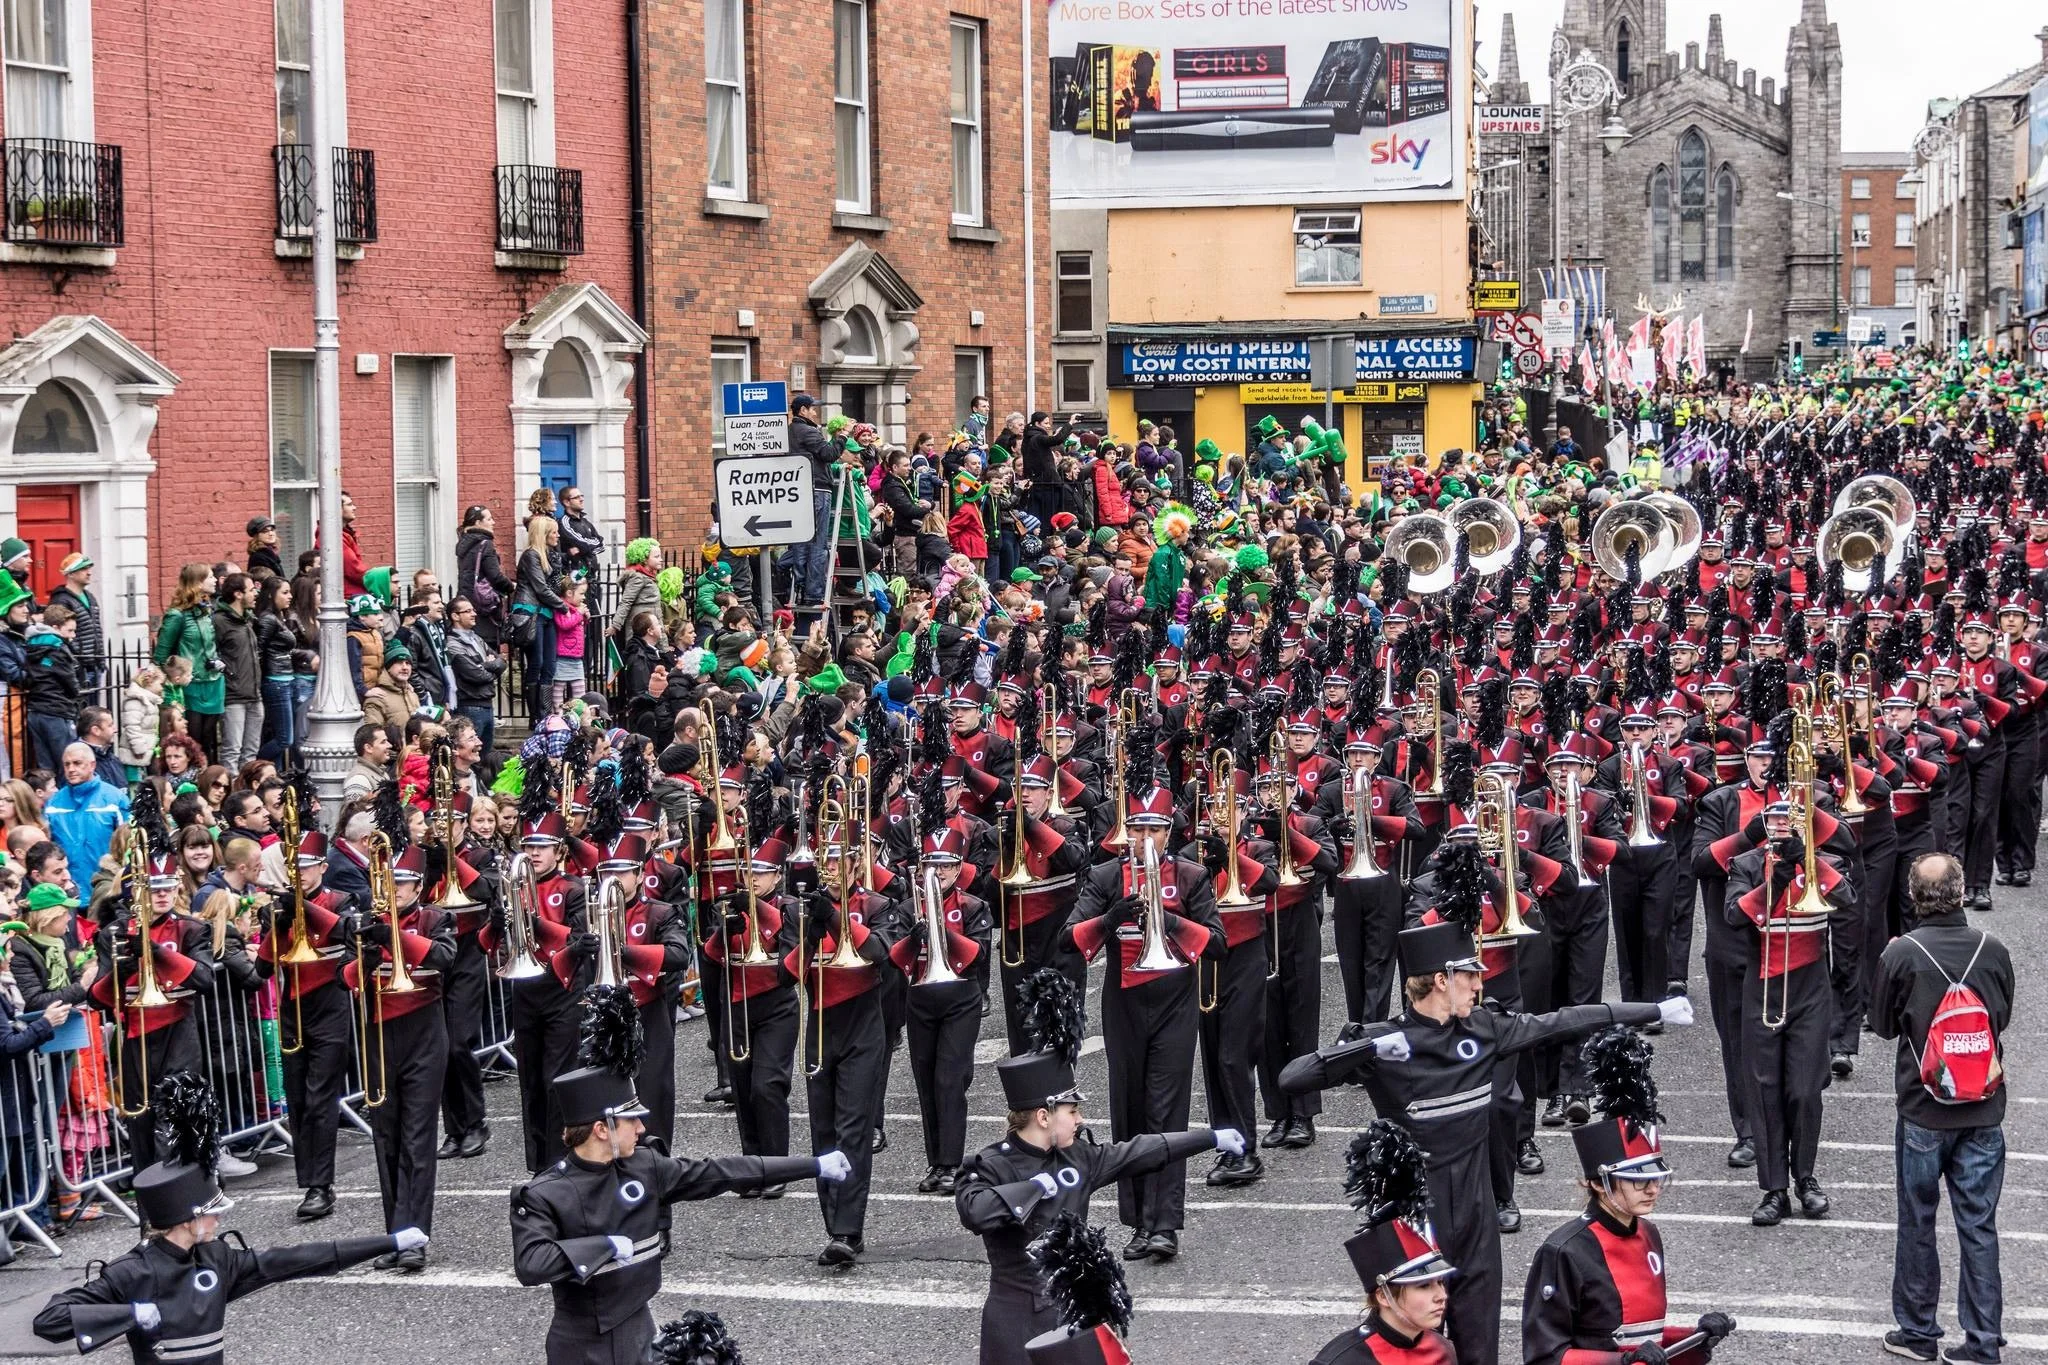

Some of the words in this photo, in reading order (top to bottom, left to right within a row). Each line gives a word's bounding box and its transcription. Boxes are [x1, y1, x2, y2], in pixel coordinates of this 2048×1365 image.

[1060, 3, 1112, 21] More
[1118, 1, 1154, 20] Box
[1160, 0, 1206, 19] Sets
[1211, 0, 1232, 17] of
[1238, 0, 1272, 16] the
[1279, 0, 1336, 15] latest
[1342, 0, 1408, 13] shows
[1192, 53, 1269, 74] GIRLS
[1391, 84, 1401, 111] MEN
[1408, 100, 1446, 117] BONES
[1481, 107, 1542, 118] LOUNGE
[1482, 121, 1540, 132] UPSTAIRS
[1371, 133, 1431, 170] sky
[1407, 304, 1423, 312] LANE
[1186, 342, 1233, 355] HIGH
[1239, 341, 1295, 355] SPEED
[1395, 338, 1462, 353] ACCESS
[1132, 358, 1176, 372] LOW
[1182, 357, 1231, 371] COST
[1402, 354, 1463, 368] CALLS
[1523, 355, 1537, 367] 50
[1134, 374, 1155, 383] FAX
[1168, 373, 1253, 382] PHOTOCOPYING
[1269, 372, 1292, 381] CV's
[1407, 370, 1463, 379] SCANNING
[1397, 383, 1424, 400] yes!
[731, 421, 752, 429] Luan
[757, 419, 783, 428] Domh
[741, 432, 753, 441] 24
[733, 443, 756, 451] MON
[762, 441, 782, 450] SUN
[729, 465, 803, 486] Rampaí
[731, 487, 800, 507] RAMPS
[1944, 1031, 1988, 1042] owasso
[1457, 1039, 1478, 1059] O
[1058, 1168, 1079, 1186] O
[620, 1181, 644, 1201] O
[1648, 1252, 1661, 1275] O
[194, 1270, 218, 1291] O
